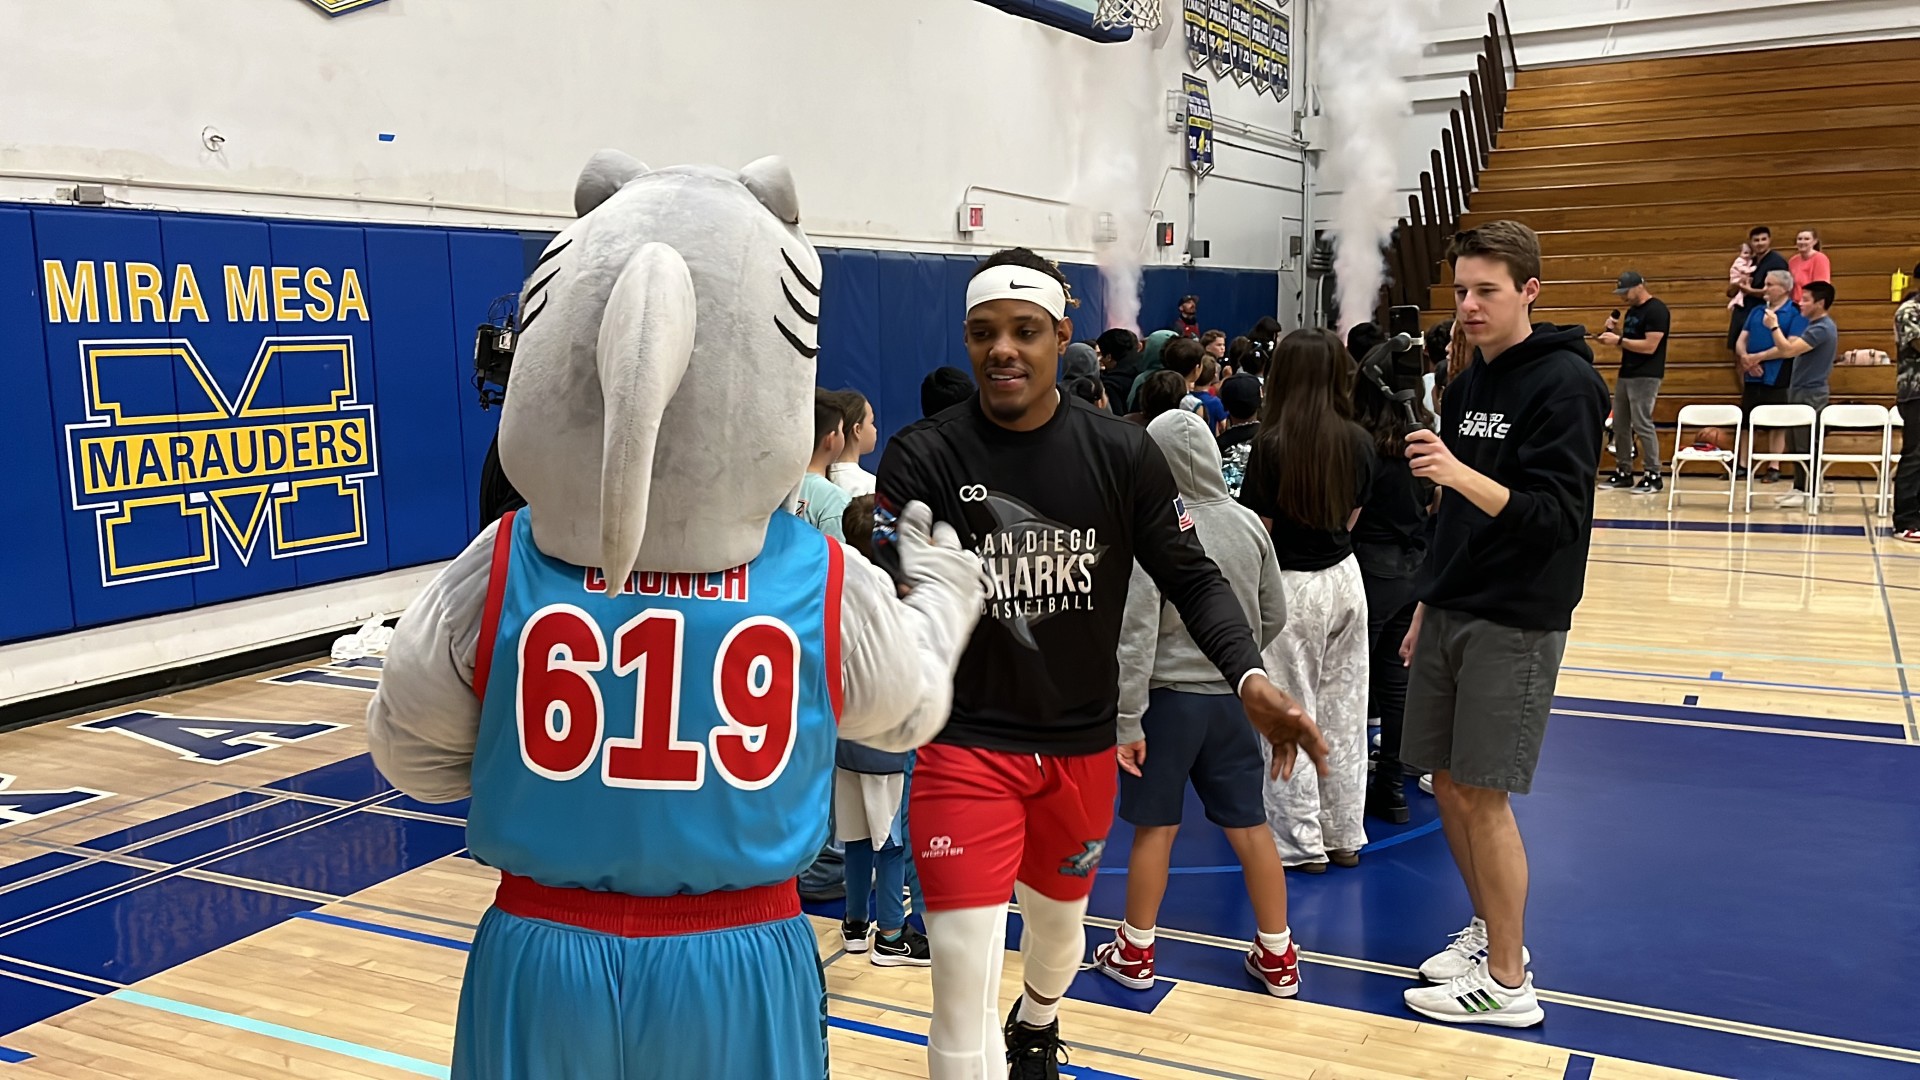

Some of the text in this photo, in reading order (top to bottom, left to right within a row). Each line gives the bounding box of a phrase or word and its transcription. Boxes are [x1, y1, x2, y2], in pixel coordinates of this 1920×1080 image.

[43, 259, 369, 323] MIRA MESA
[1458, 420, 1511, 439] ARKS
[88, 421, 362, 490] MARAUDERS
[1026, 527, 1096, 553] DIEGO
[583, 563, 749, 602] CUNCH
[516, 603, 801, 790] 619
